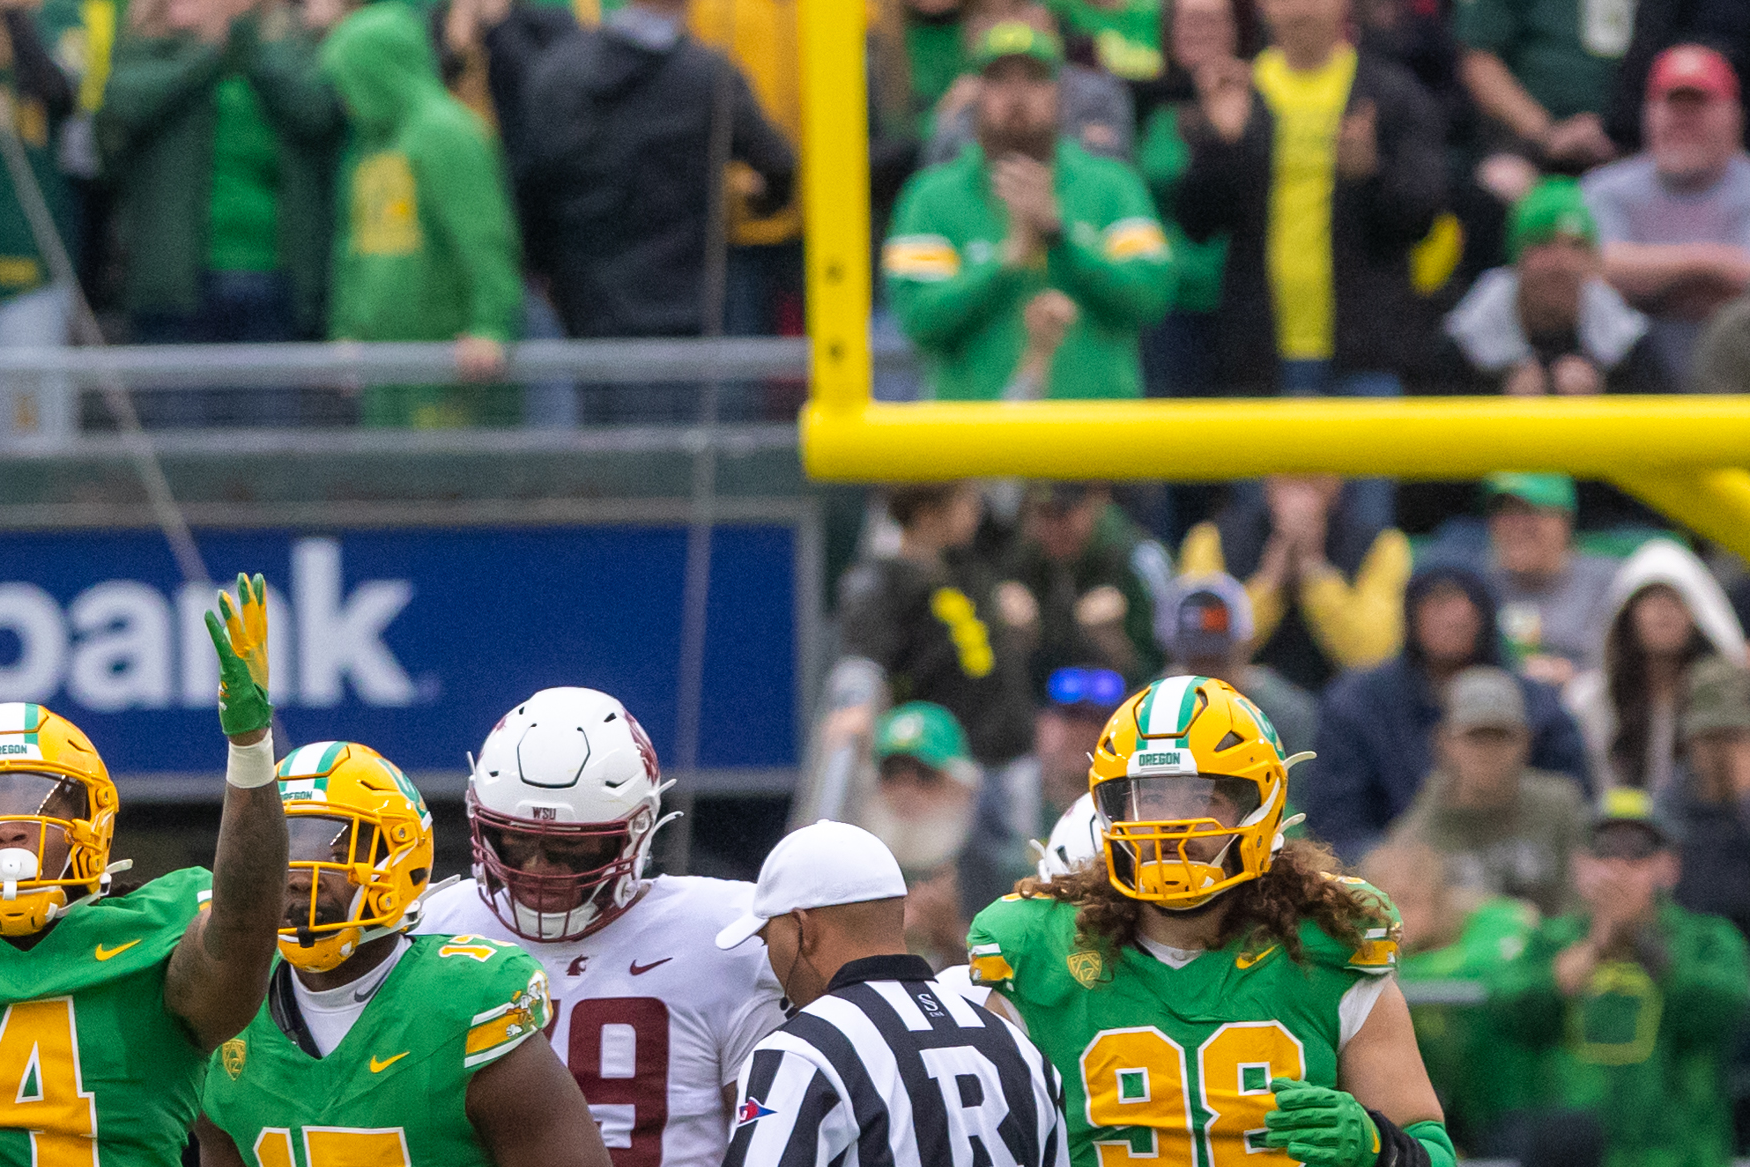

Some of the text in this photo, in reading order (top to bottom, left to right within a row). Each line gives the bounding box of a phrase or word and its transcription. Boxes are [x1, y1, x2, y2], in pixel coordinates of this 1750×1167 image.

[1138, 752, 1181, 766] OREGON
[532, 806, 557, 820] WSU
[1079, 967, 1096, 981] 12
